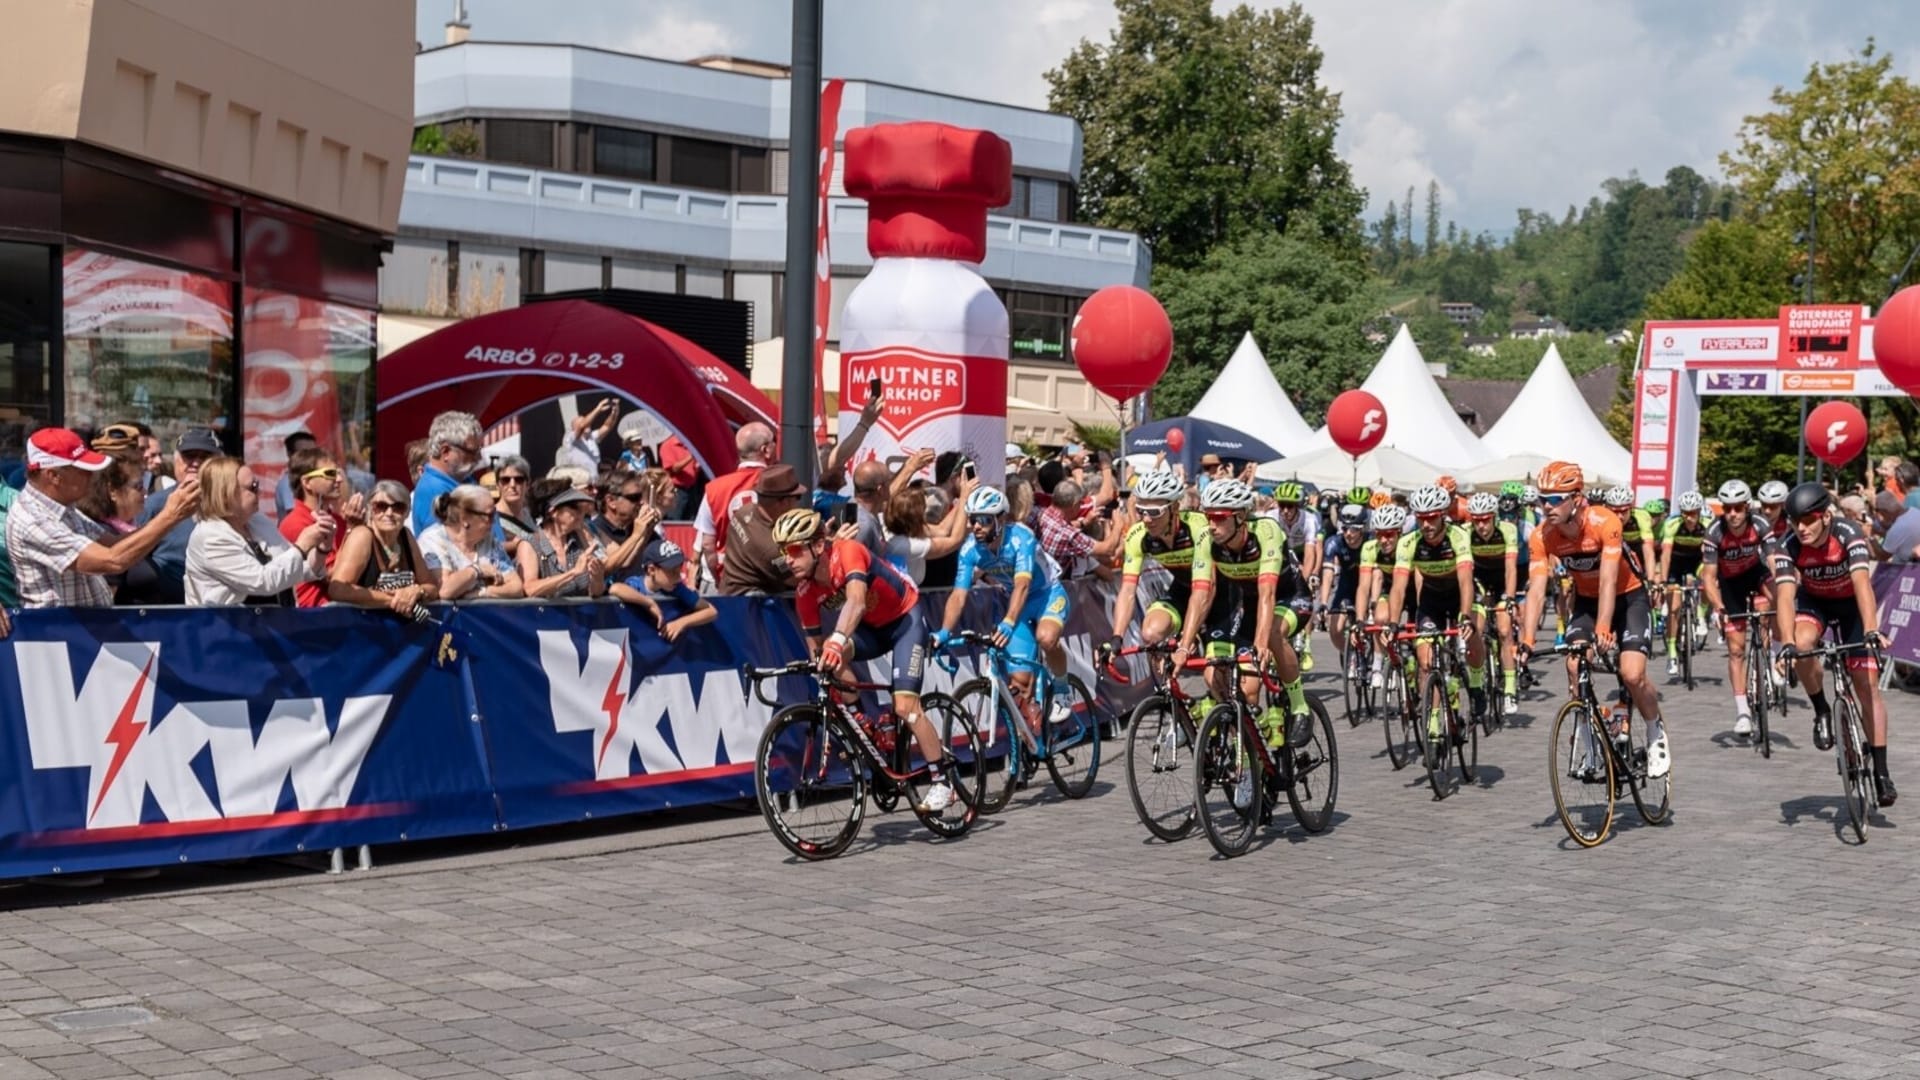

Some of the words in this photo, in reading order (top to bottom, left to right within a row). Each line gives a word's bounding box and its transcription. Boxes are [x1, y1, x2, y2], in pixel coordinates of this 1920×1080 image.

[1789, 309, 1853, 320] ÖSTERREICH
[1789, 319, 1851, 329] RUNDFAHRT
[465, 345, 536, 366] ARBÖ
[568, 353, 624, 369] 1-2-3
[852, 366, 958, 386] MAUTNER
[863, 386, 942, 402] MRKHOF
[888, 406, 912, 416] 1841
[1804, 566, 1821, 577] MY
[1825, 561, 1849, 575] BIKE
